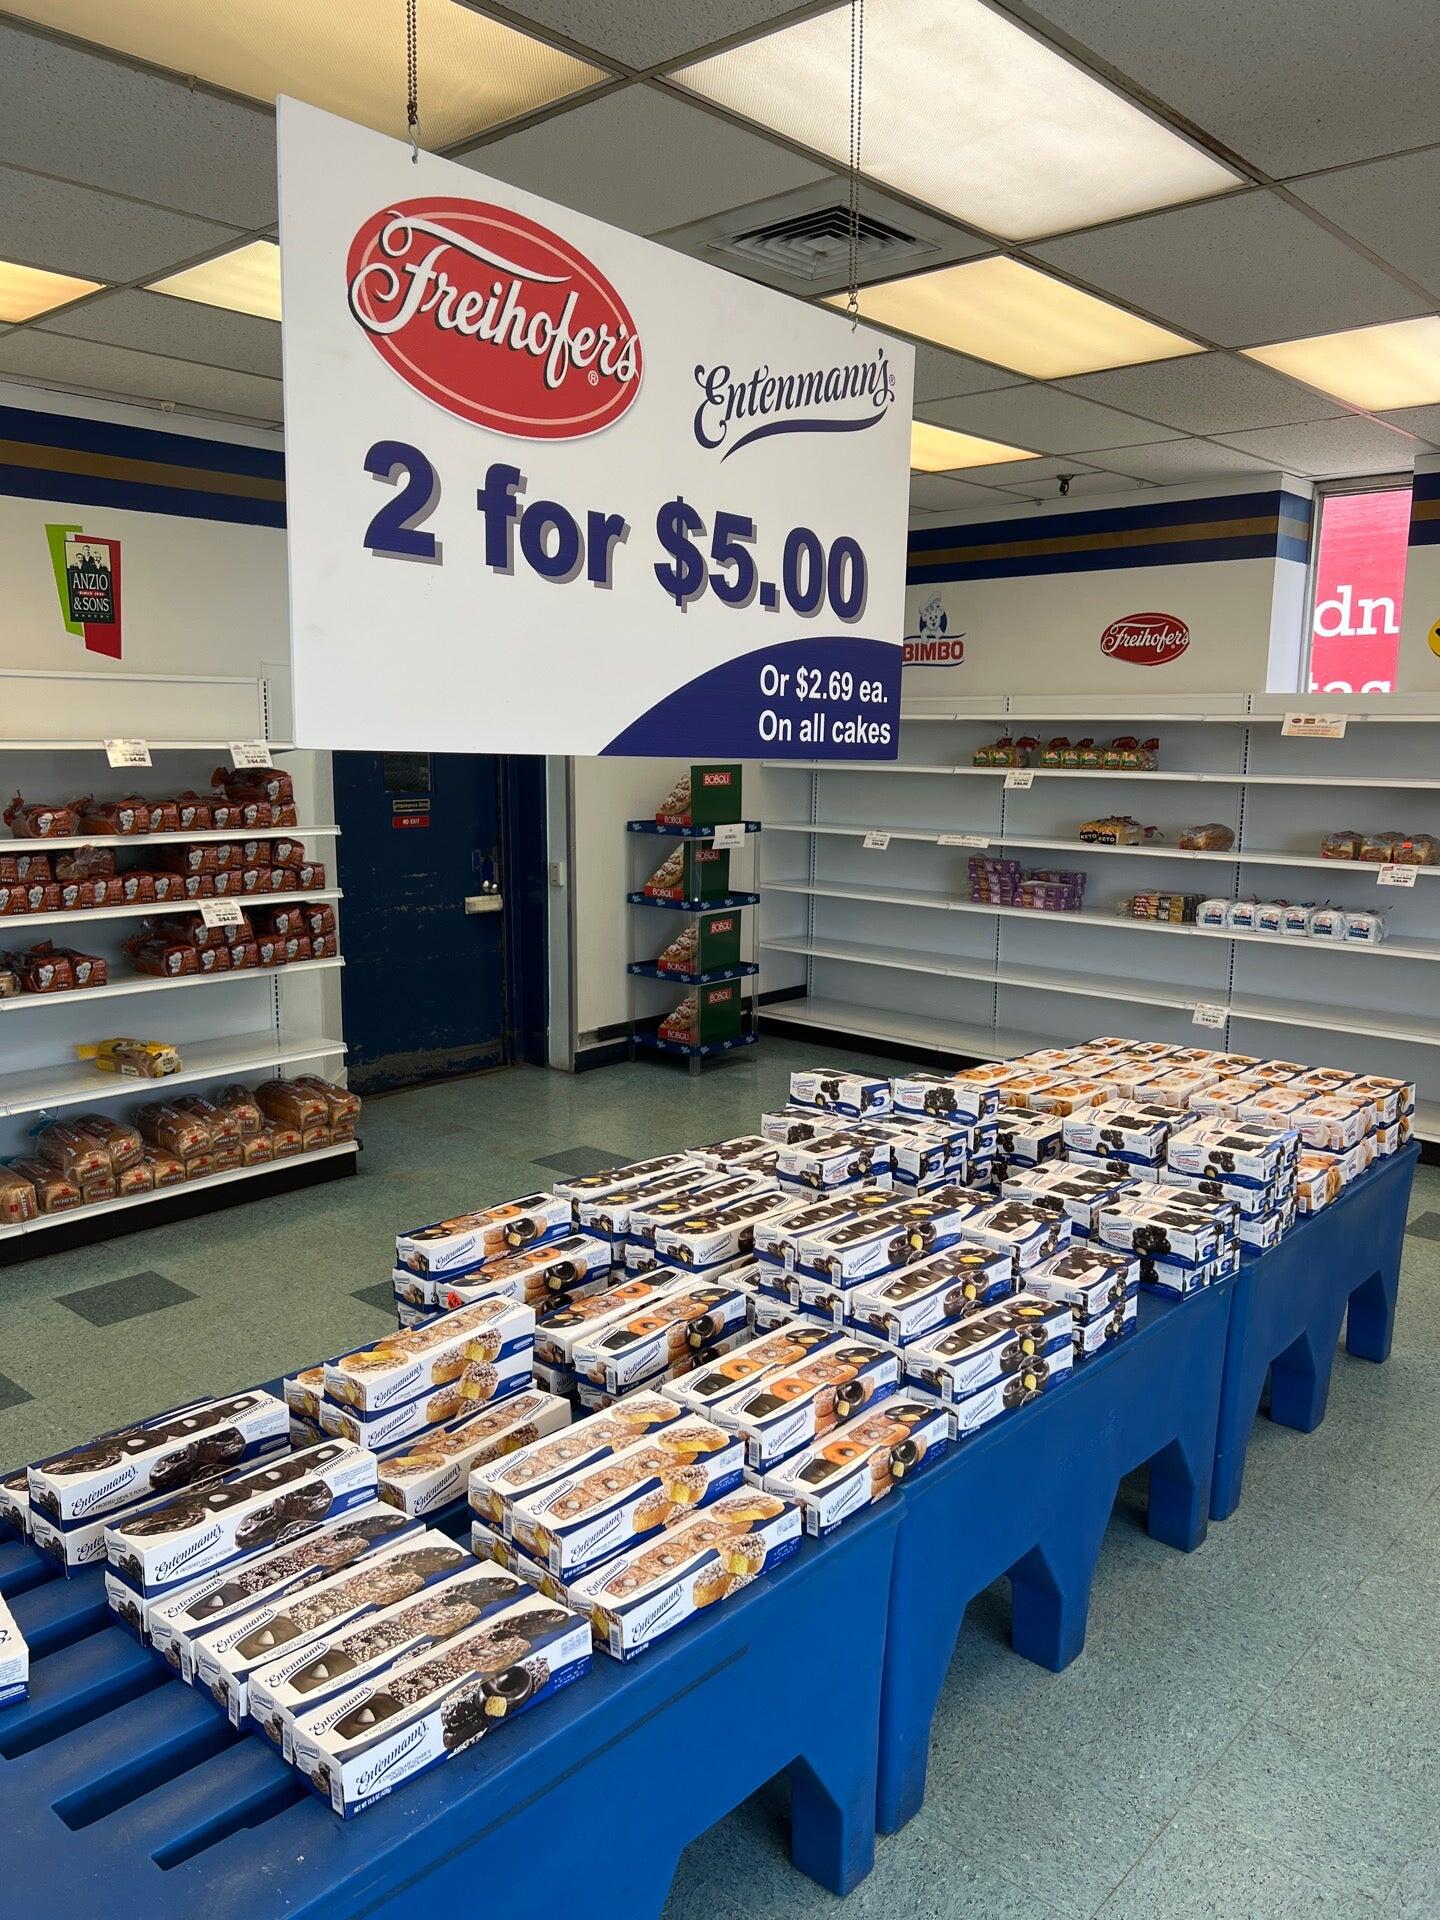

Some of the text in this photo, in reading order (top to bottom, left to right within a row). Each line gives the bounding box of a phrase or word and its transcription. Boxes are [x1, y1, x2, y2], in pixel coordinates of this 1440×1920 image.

[351, 211, 639, 389] Freihofer's
[695, 348, 893, 450] Entenmann's
[363, 440, 869, 623] 2 for $5.00
[73, 573, 108, 590] ANZIO
[903, 640, 964, 661] BIMBO
[1101, 622, 1189, 653] Freihofer's
[760, 664, 888, 703] Or $2.69 ea.
[758, 710, 891, 745] On all cakes
[705, 775, 729, 784] BOBOLI
[652, 888, 674, 898] BOBOLI
[711, 921, 732, 932] BOBOLI
[667, 962, 689, 972] BOBOLI
[710, 991, 731, 1002] BOBOLI
[667, 1030, 689, 1040] BOBOLI
[374, 1363, 424, 1408] Entenmann's
[368, 1401, 418, 1447] Entenmann's
[483, 1450, 527, 1483] Entenmann's
[71, 1465, 138, 1516] Entenmann's
[414, 1463, 462, 1514] Entenmann's
[528, 1480, 573, 1515] Entenmann's
[155, 1524, 223, 1581] Entenmann's
[571, 1509, 624, 1563] Entenmann's
[163, 1577, 224, 1617] Entenmann's
[583, 1559, 627, 1596] Entenmann's
[212, 1608, 276, 1653] Entenmann's
[632, 1583, 684, 1643] Entenmann's
[265, 1641, 327, 1688] Entenmann's
[309, 1686, 372, 1736] Entenmann's
[356, 1720, 429, 1796] Entenmann's
